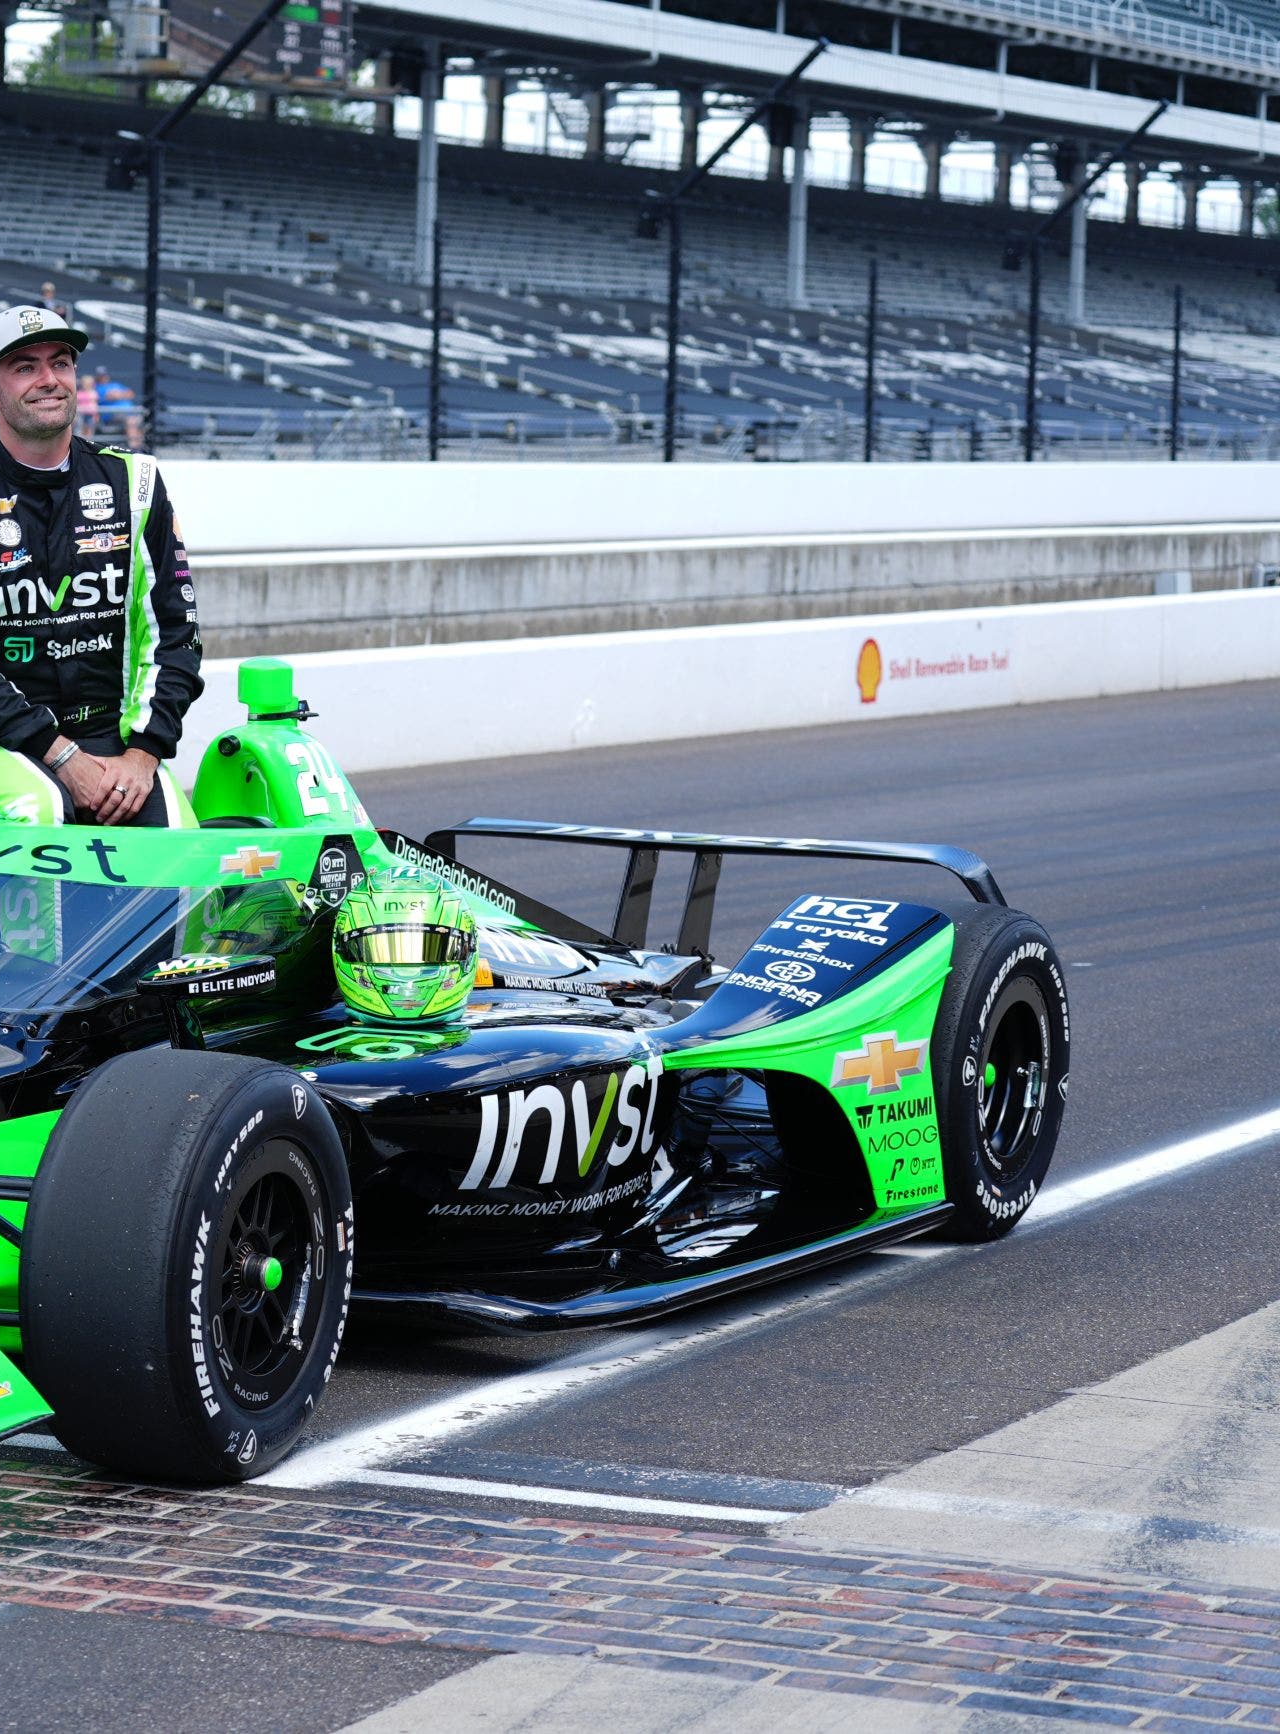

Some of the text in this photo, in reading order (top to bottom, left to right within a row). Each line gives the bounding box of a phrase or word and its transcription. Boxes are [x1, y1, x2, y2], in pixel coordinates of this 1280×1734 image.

[94, 489, 109, 497] NTT
[138, 462, 149, 502] sparco
[81, 498, 114, 506] INDYCAR
[93, 522, 126, 531] HARVEY
[80, 611, 95, 620] FOR
[98, 607, 125, 619] PEOPLE
[889, 650, 1010, 680] Shell Renewable Race Fuel
[285, 740, 349, 817] 24
[332, 858, 344, 868] NTT
[320, 873, 347, 884] INDYCAR
[384, 900, 426, 911] invst
[790, 895, 893, 932] hc1
[795, 923, 888, 946] aryaka
[157, 955, 233, 972] WIX
[751, 943, 855, 971] ShredShox
[202, 978, 235, 993] ELITE
[237, 970, 275, 988] INDYCAR
[504, 974, 531, 988] MAKING
[531, 977, 555, 991] MONEY
[555, 980, 574, 993] WORK
[574, 982, 587, 995] FOR
[586, 983, 607, 998] PEOPLE
[724, 979, 815, 1007] WOUND CARE
[728, 972, 823, 1003] INDIANA
[979, 942, 1047, 1033] FIREHAWK
[1049, 964, 1069, 1042] INDY 500
[458, 1052, 664, 1190] invst
[877, 1096, 932, 1125] TAKUMI
[215, 1110, 263, 1193] INDY 500
[868, 1125, 937, 1154] MOOG
[288, 1151, 317, 1196] RACING
[427, 1203, 510, 1216] MAKING
[508, 1199, 572, 1216] MONEY
[569, 1195, 604, 1214] WORK
[604, 1184, 622, 1207] FOR
[886, 1184, 939, 1204] Firestone
[976, 1178, 1037, 1219] Firestone
[323, 1201, 354, 1384] Firestone
[190, 1209, 221, 1418] FIREHAWK
[234, 1383, 269, 1402] RACING
